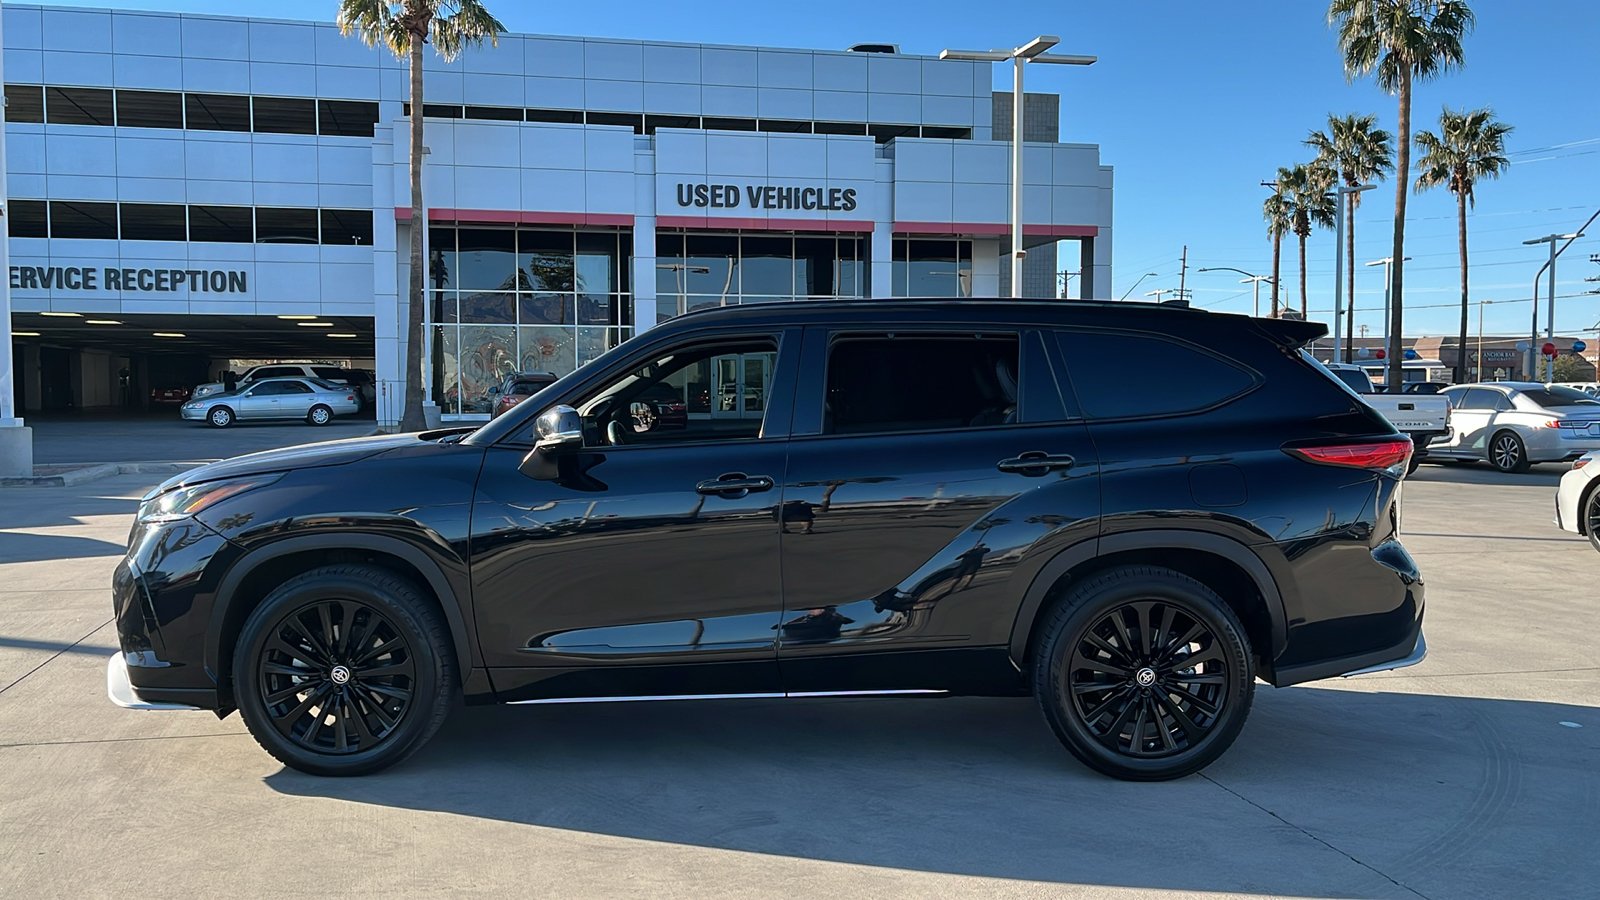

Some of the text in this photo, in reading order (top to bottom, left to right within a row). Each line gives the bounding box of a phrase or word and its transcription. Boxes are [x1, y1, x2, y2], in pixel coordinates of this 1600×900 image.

[677, 183, 857, 211] USED VEHICLES
[9, 266, 247, 293] ERVICE RECEPTION
[1225, 624, 1246, 698] YOKOHAMA
